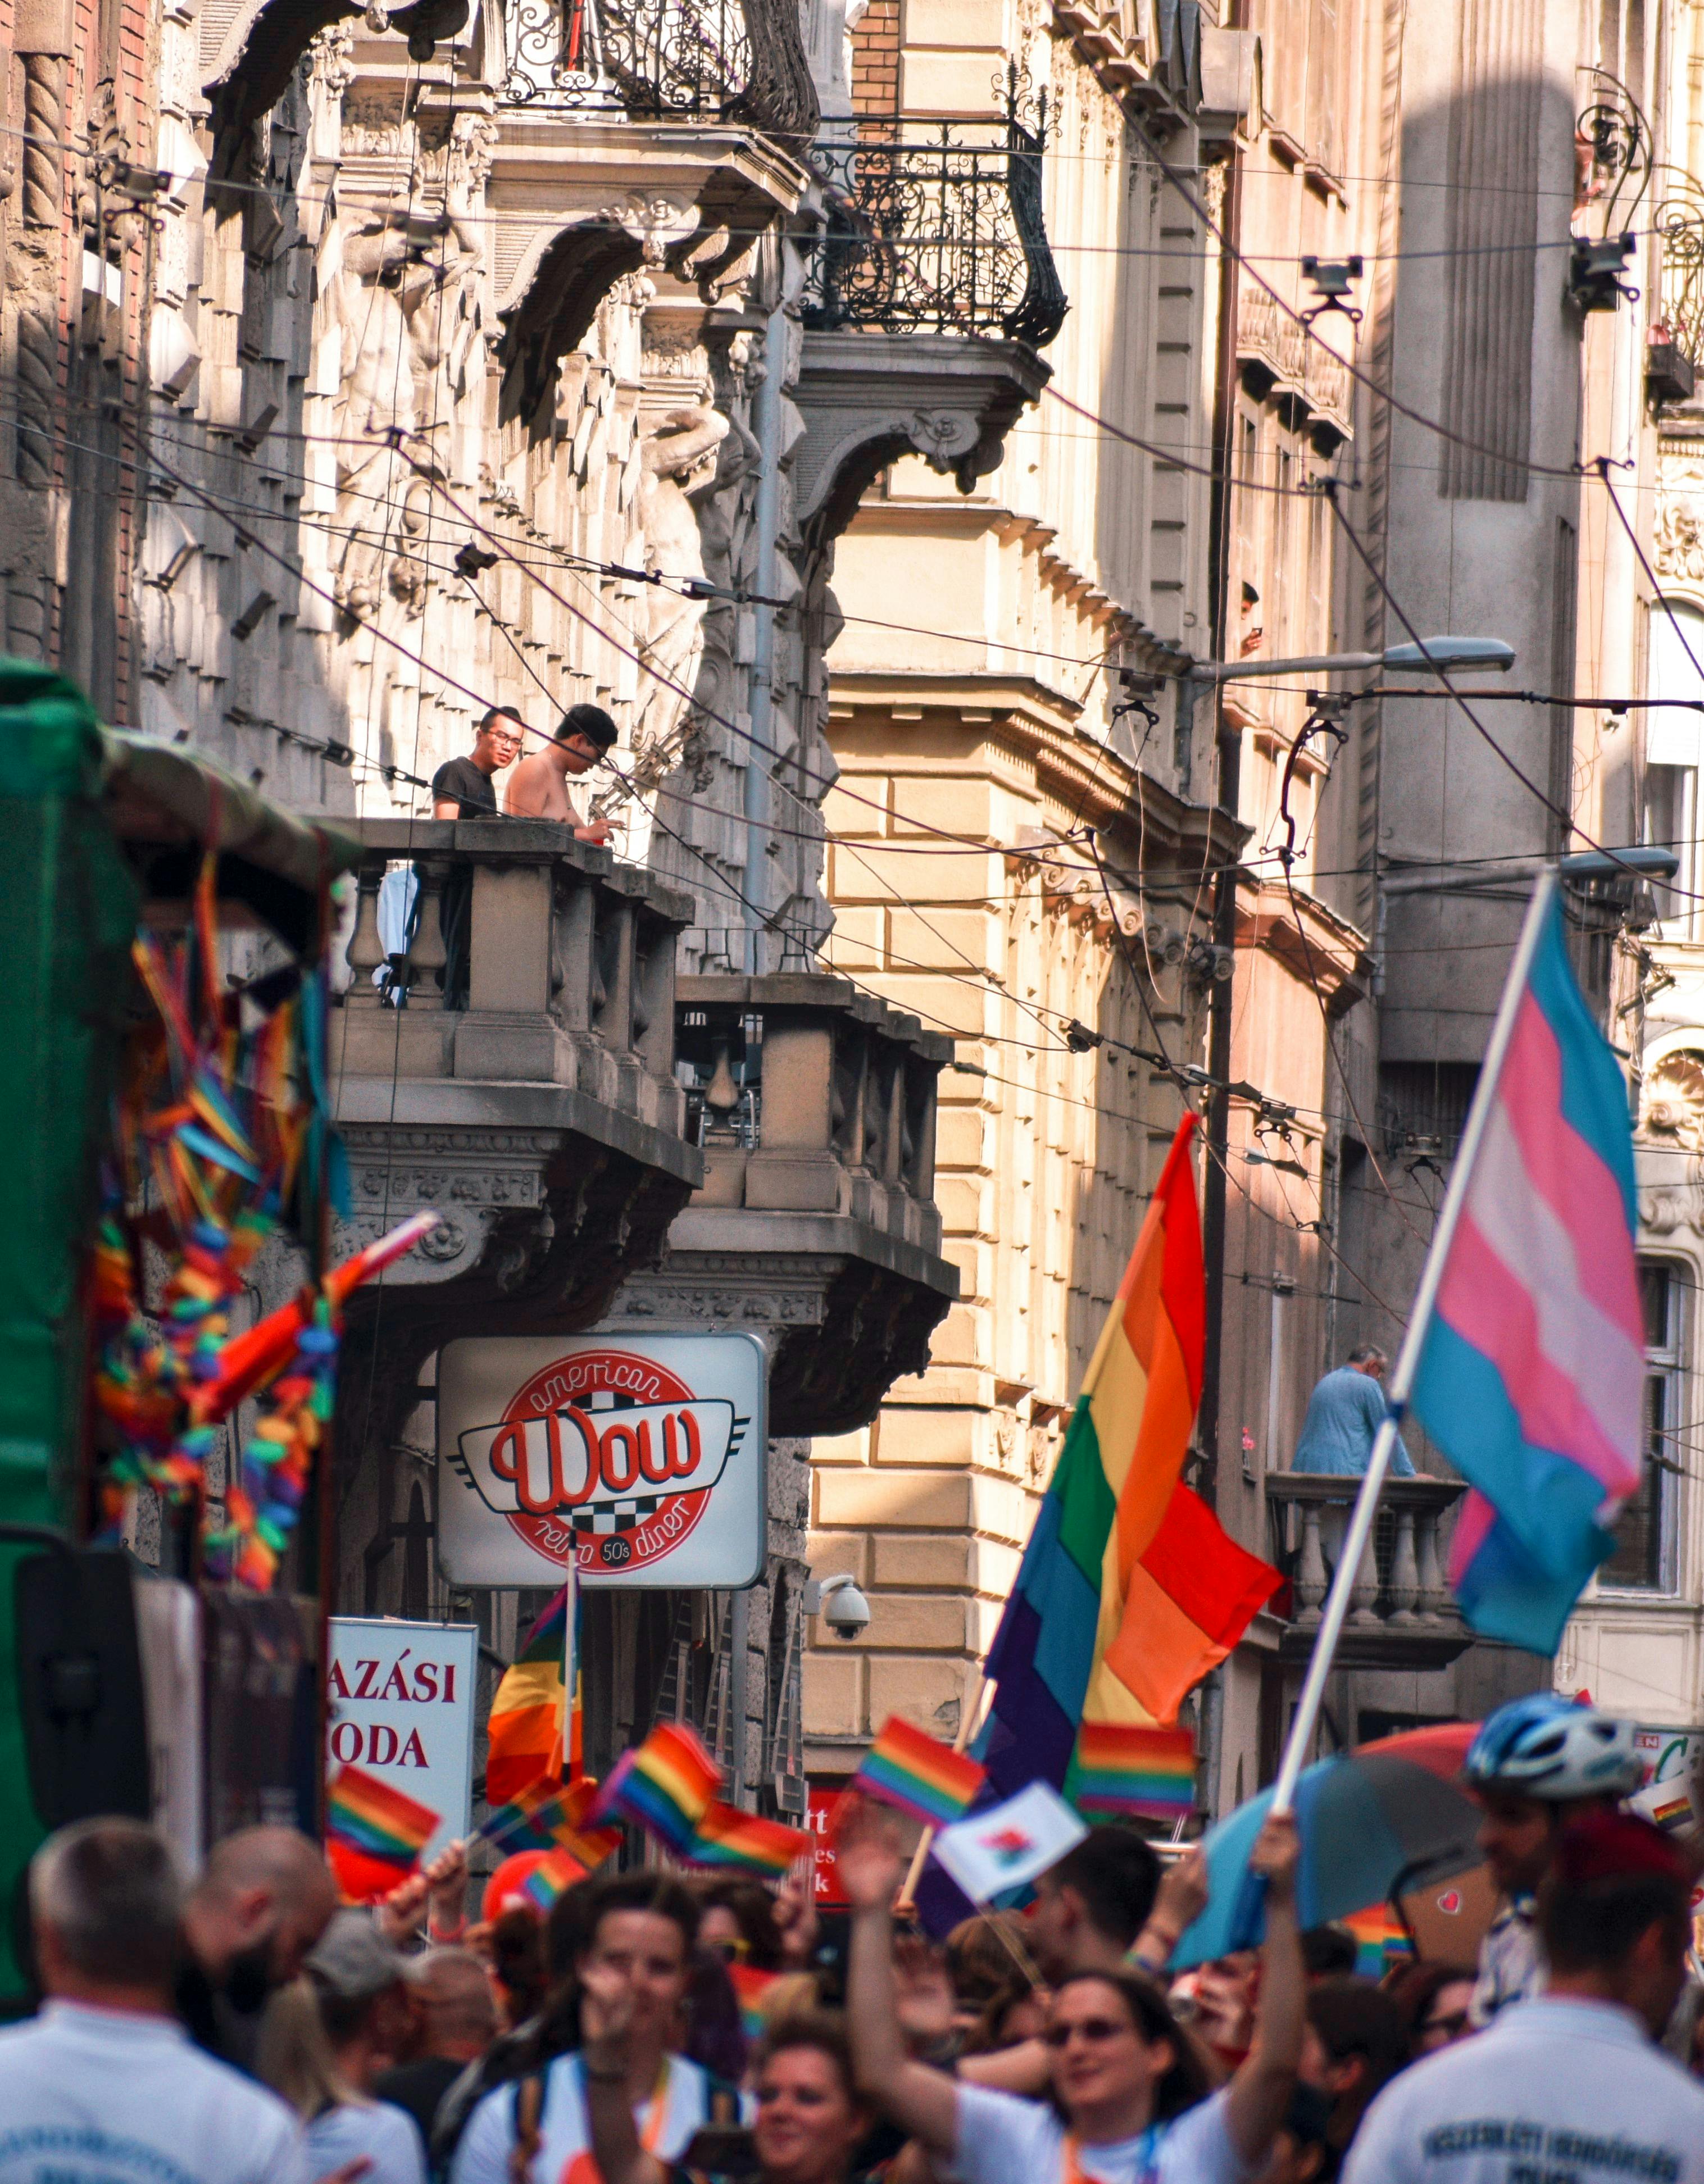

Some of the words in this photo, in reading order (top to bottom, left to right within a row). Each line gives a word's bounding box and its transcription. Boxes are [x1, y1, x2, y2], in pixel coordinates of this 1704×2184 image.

[530, 1359, 661, 1413] american
[603, 1543, 630, 1561] 50's
[635, 1498, 690, 1557] diner
